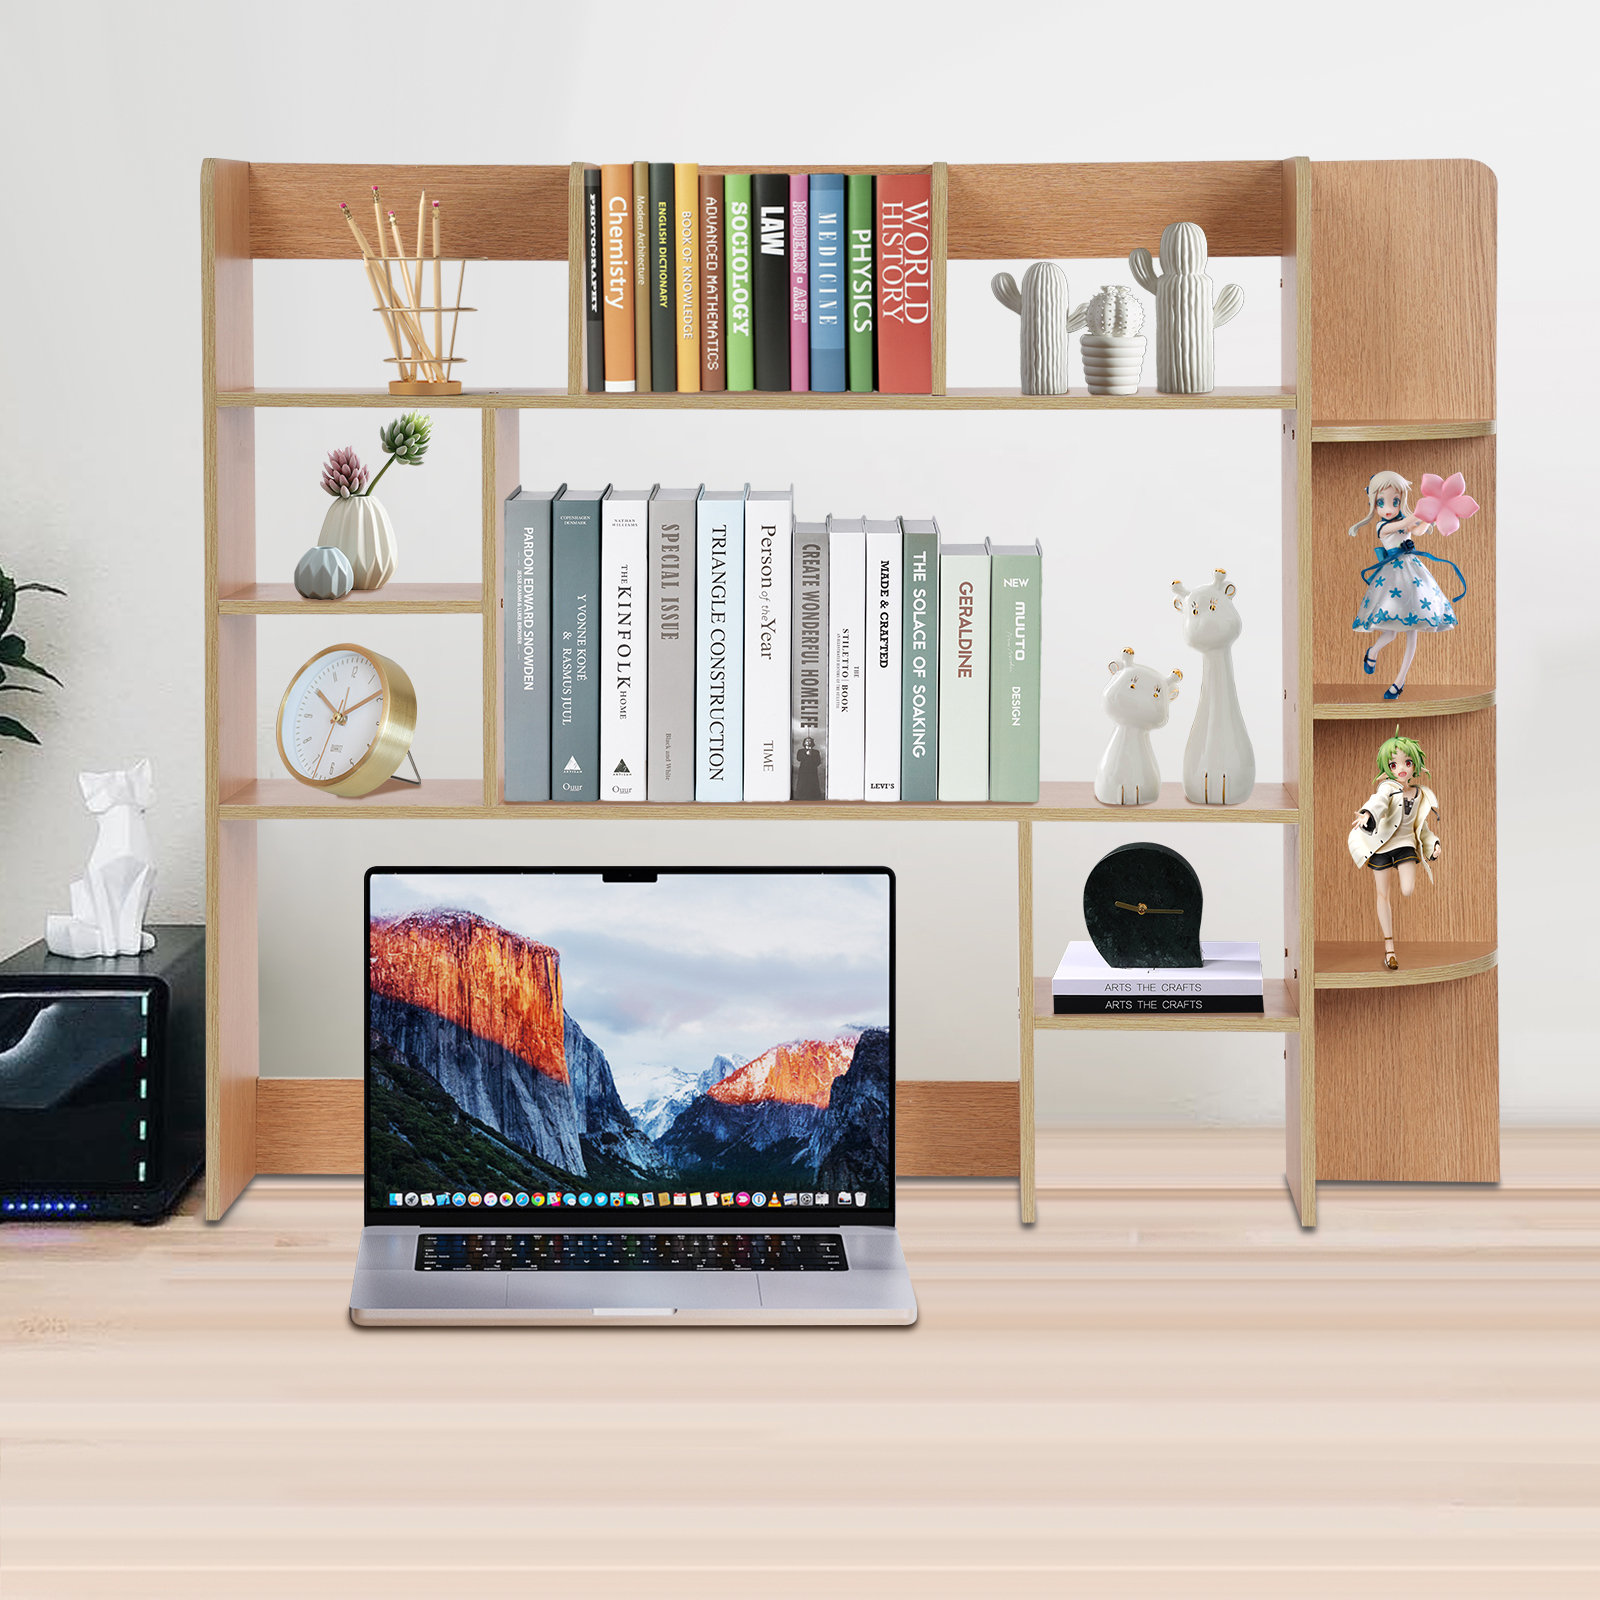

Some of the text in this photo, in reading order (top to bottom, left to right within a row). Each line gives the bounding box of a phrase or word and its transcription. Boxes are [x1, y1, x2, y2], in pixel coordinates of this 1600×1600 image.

[589, 193, 598, 312] PHOTOGRAPHY
[605, 196, 628, 309] Chemistry
[637, 195, 645, 285] Modern Architecture
[658, 202, 668, 309] ENGLISH DICTIONARY
[682, 211, 694, 340] BOOK OF KNOWLEDGE
[705, 196, 719, 371] ADVANCED MATHEMATICS
[731, 201, 749, 337] SOCIOLOGY
[761, 206, 785, 256] LAW
[792, 201, 808, 324] MODERN ART
[818, 212, 838, 325] MEDICINE
[852, 229, 872, 333] PHYSICS
[882, 201, 904, 324] HISTORY
[903, 199, 929, 324] WORLD
[523, 527, 534, 691] PARDON EDWARD SNOWDEN
[661, 524, 680, 640] SPECIAL ISSUE
[759, 525, 777, 660] Person of the Year
[800, 543, 821, 728] CREATE WONDERFUL HOMELIFE
[880, 560, 890, 669] MADE & CRAFTED
[958, 581, 973, 678] GERALDINE
[1003, 578, 1029, 588] NEW
[561, 631, 572, 726] & RASMUS JUUL
[576, 594, 587, 681] YVONNE KONÉ
[617, 586, 632, 689] KINFOLK
[709, 525, 727, 781] TRIANGLE CONSTRUCTION
[912, 551, 927, 758] THE SOLACE OF SOAKING
[619, 691, 627, 720] HOME
[841, 684, 849, 713] BOOK
[1011, 686, 1021, 727] DESIGN
[763, 740, 774, 772] TIME
[1104, 983, 1202, 992] ARTS THE CRAFTS
[1105, 1000, 1203, 1009] ARTS THE CRAFTS
